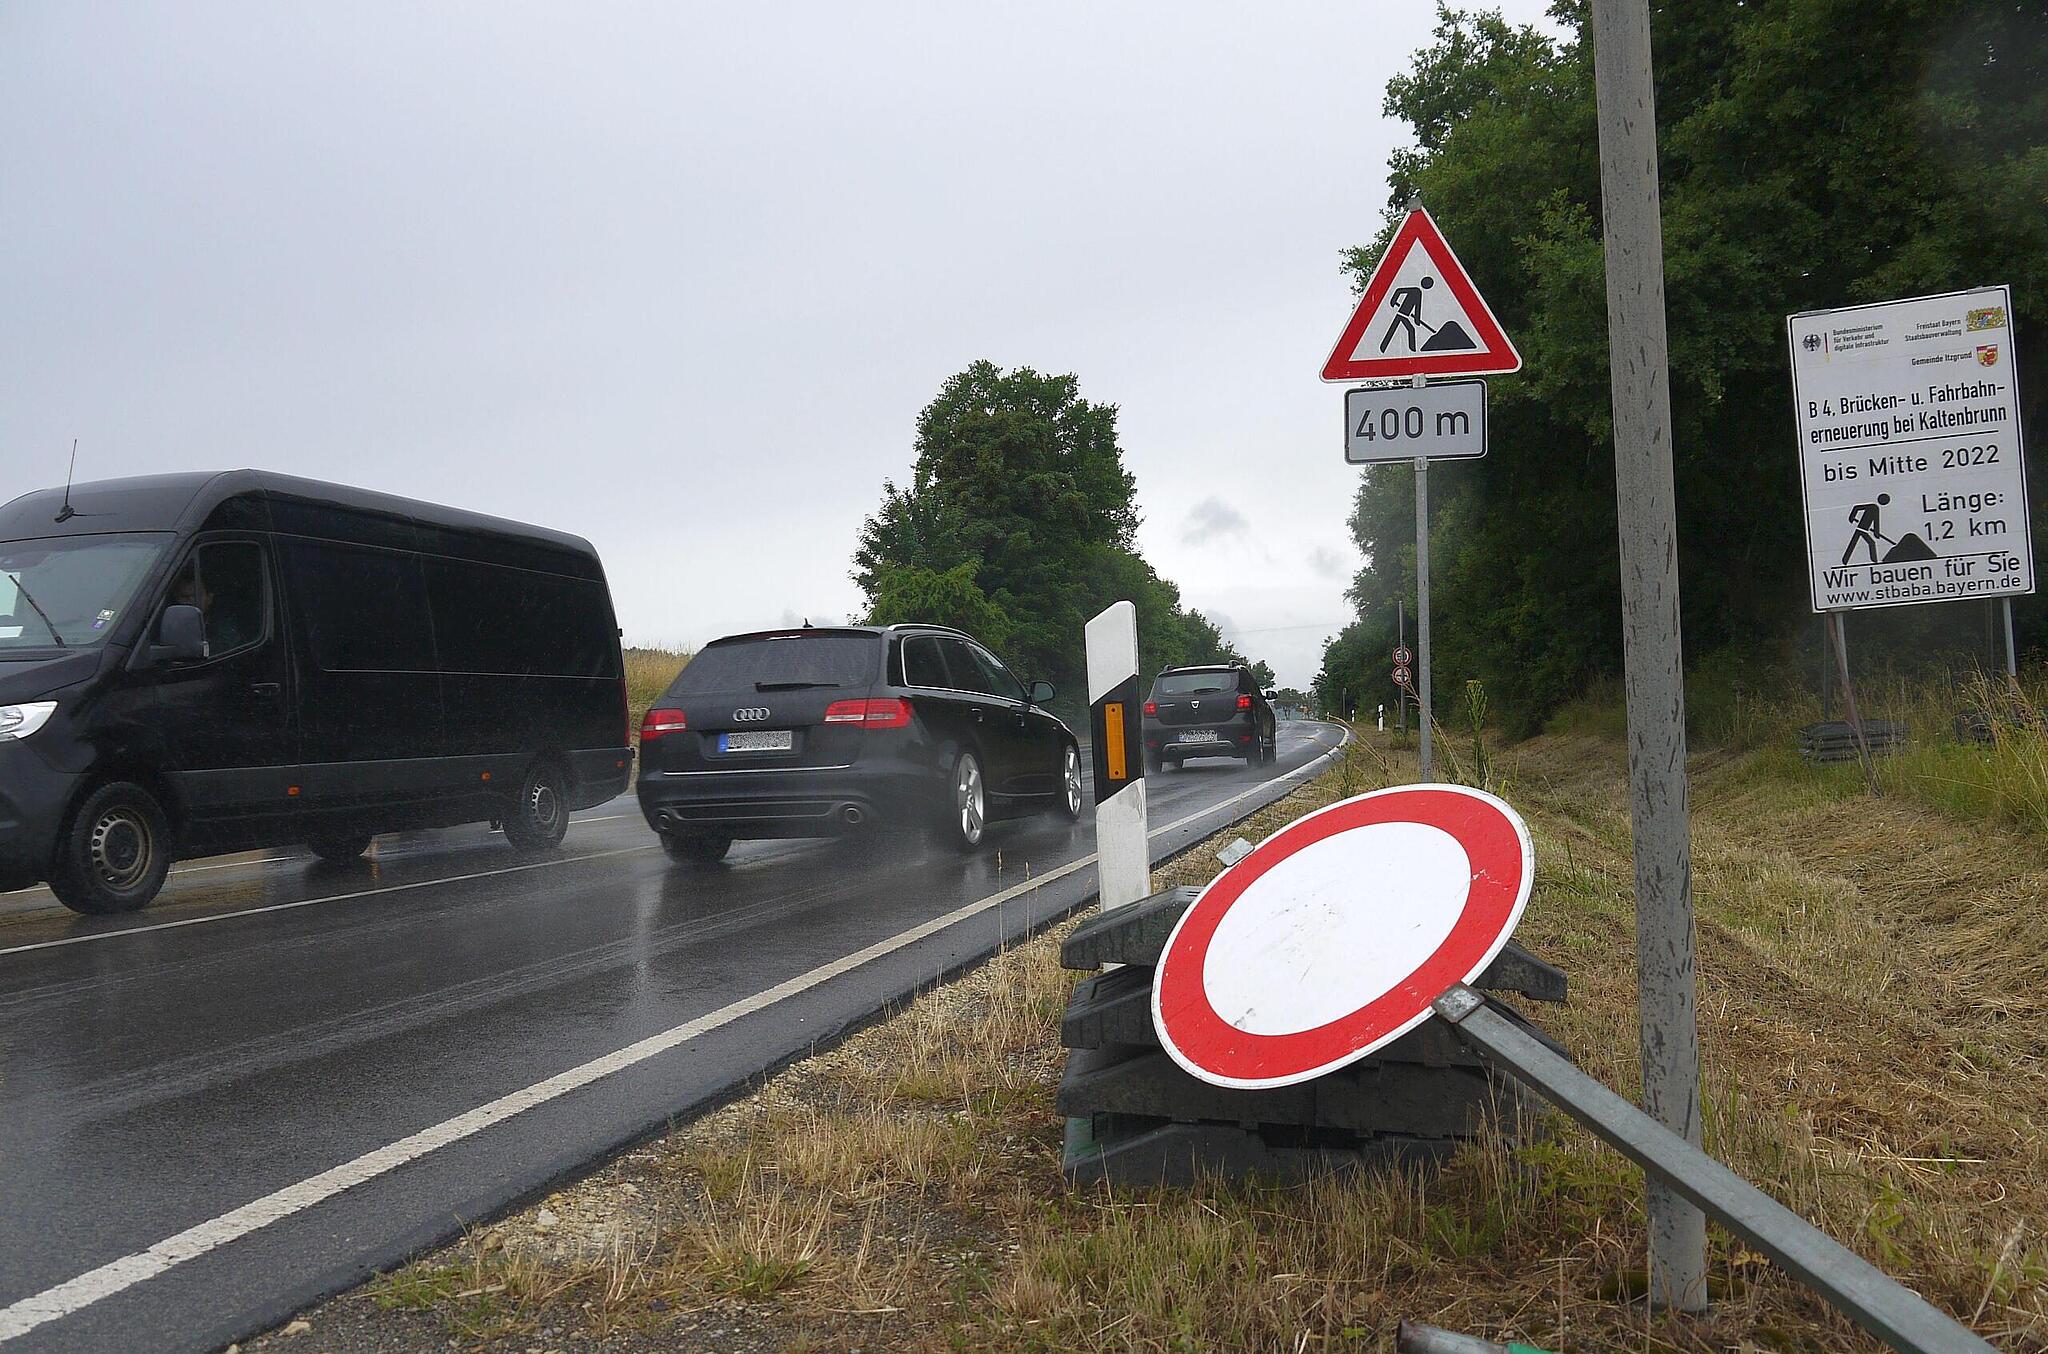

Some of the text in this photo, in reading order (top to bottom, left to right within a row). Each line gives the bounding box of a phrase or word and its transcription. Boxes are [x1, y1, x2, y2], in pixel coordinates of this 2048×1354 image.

[1911, 354, 1943, 366] Gemeinde
[1809, 401, 1818, 419] B
[1840, 393, 1906, 415] Brücken-
[1911, 391, 1925, 406] u.
[1929, 380, 2006, 404] Fahrbahn-
[1355, 406, 1470, 442] 400 m
[1810, 406, 2008, 444] erneuerung bei Kaltenbrunn
[1823, 443, 2000, 483] bis Mitte 2022
[1922, 491, 2005, 514] Länge:
[1923, 518, 2008, 542] 1,2 km
[1823, 552, 2021, 590] Wir bauen für Sie
[1826, 573, 2022, 605] www.stbaba.bayern.de
